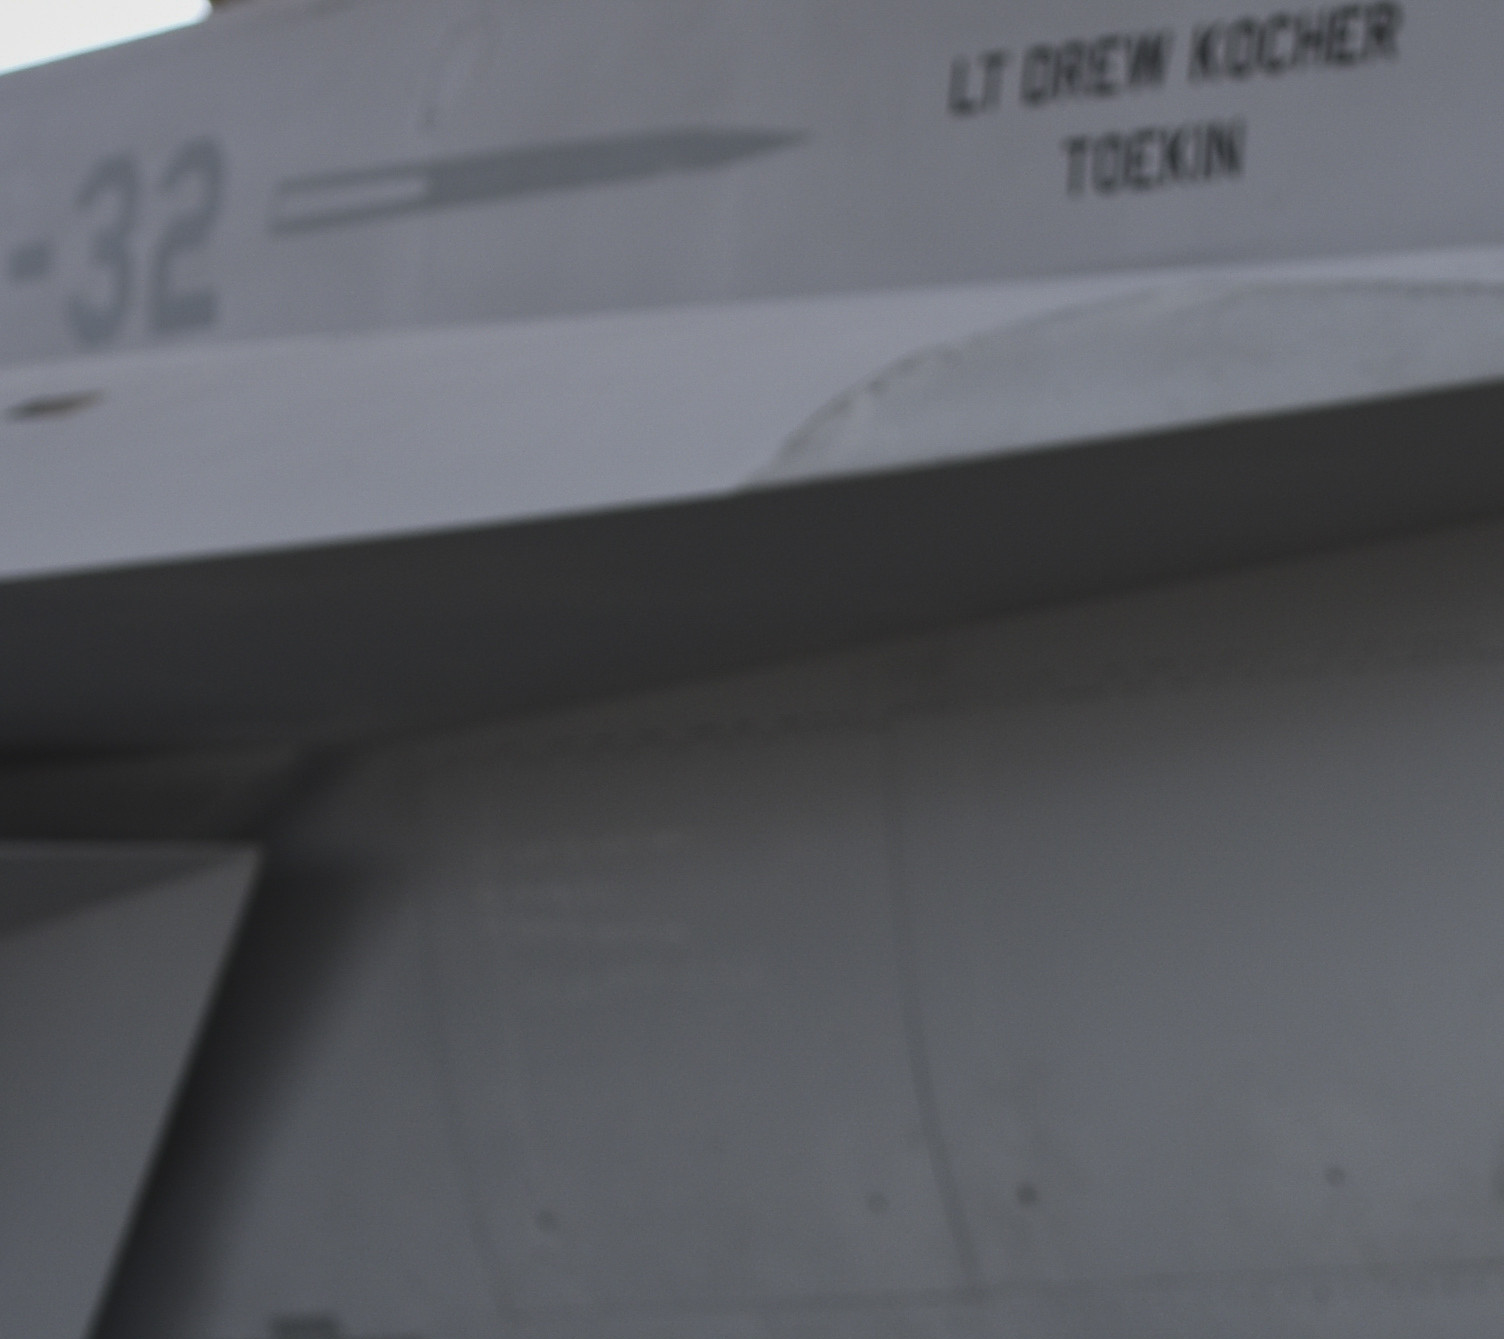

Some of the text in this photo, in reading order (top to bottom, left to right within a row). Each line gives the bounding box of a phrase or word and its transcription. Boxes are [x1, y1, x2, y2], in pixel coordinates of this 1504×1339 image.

[947, 0, 1403, 118] LT DREW KOCHER
[1060, 115, 1247, 197] TOEKIN
